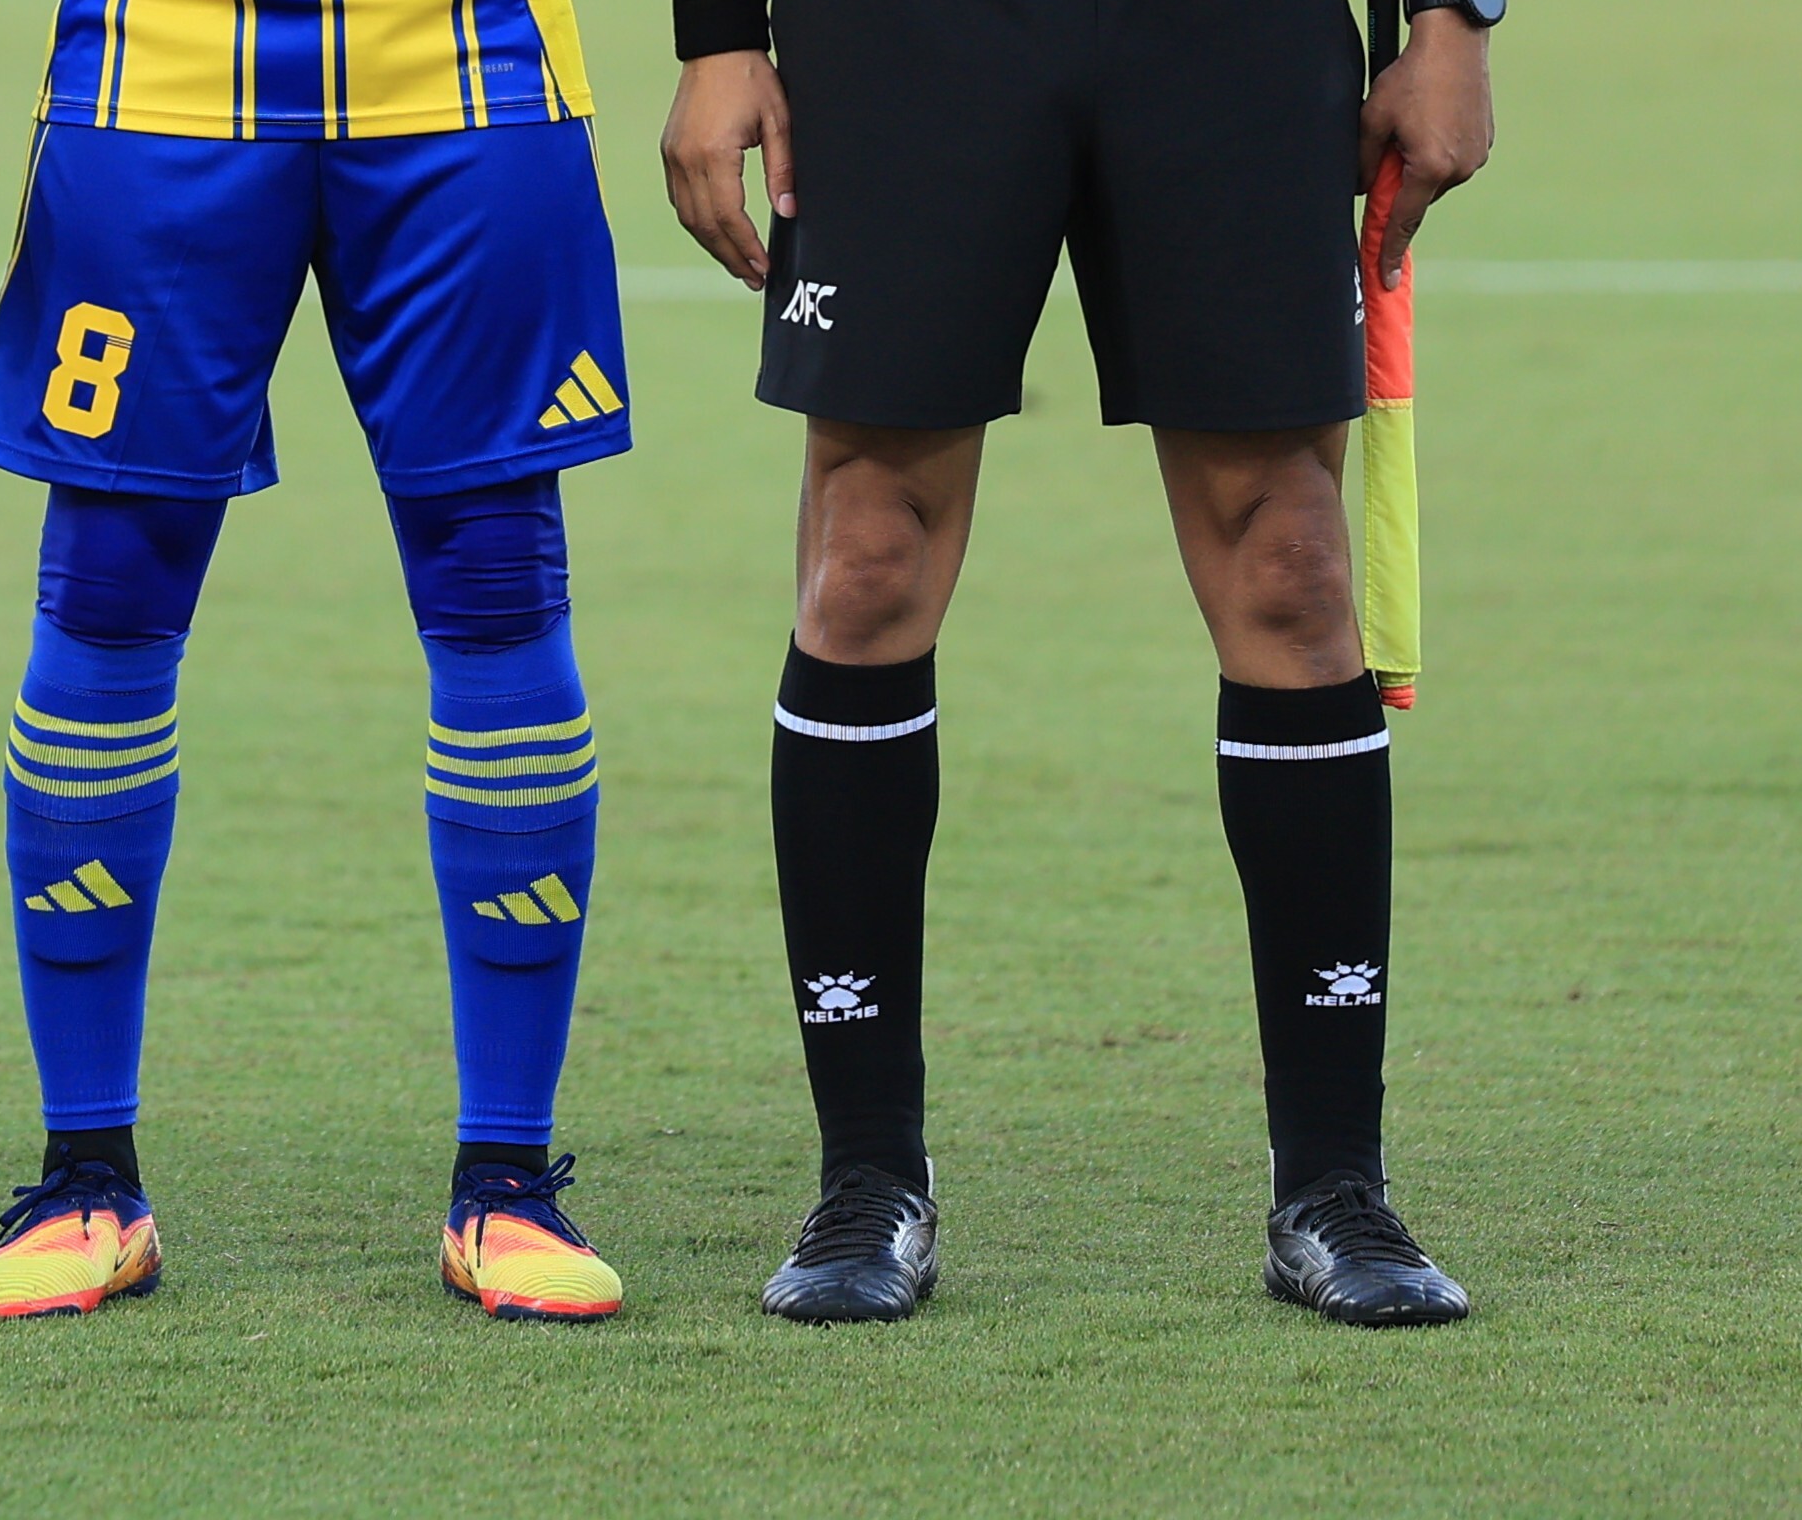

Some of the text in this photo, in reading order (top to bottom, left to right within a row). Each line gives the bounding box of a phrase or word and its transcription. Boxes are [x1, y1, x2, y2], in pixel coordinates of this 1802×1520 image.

[780, 279, 838, 330] AFC
[42, 302, 135, 439] 8
[803, 1003, 879, 1025] KELME
[1306, 991, 1382, 1007] KELME
